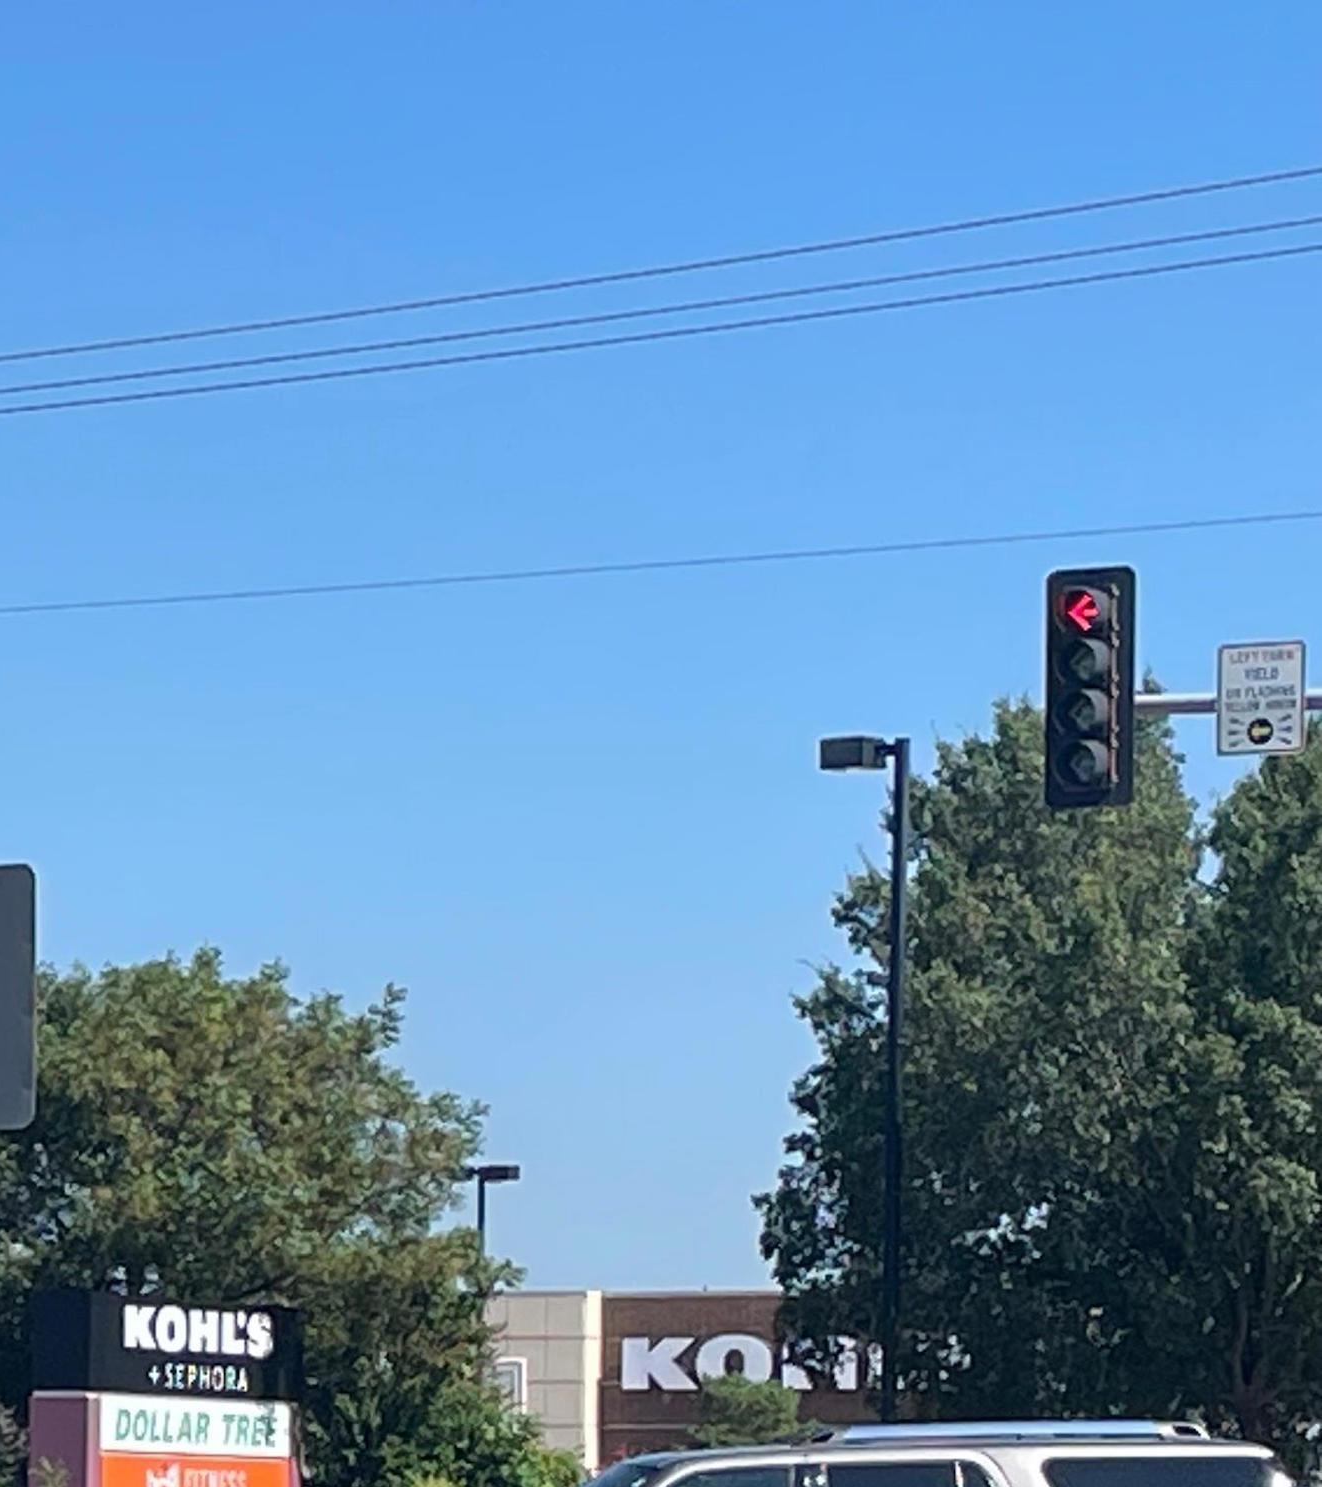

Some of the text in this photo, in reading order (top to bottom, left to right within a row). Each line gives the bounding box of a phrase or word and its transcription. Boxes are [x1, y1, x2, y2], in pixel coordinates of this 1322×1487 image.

[123, 1304, 275, 1360] KOHL'S
[164, 1362, 249, 1393] SEPHORA
[114, 1408, 277, 1448] DOLLAR TREE
